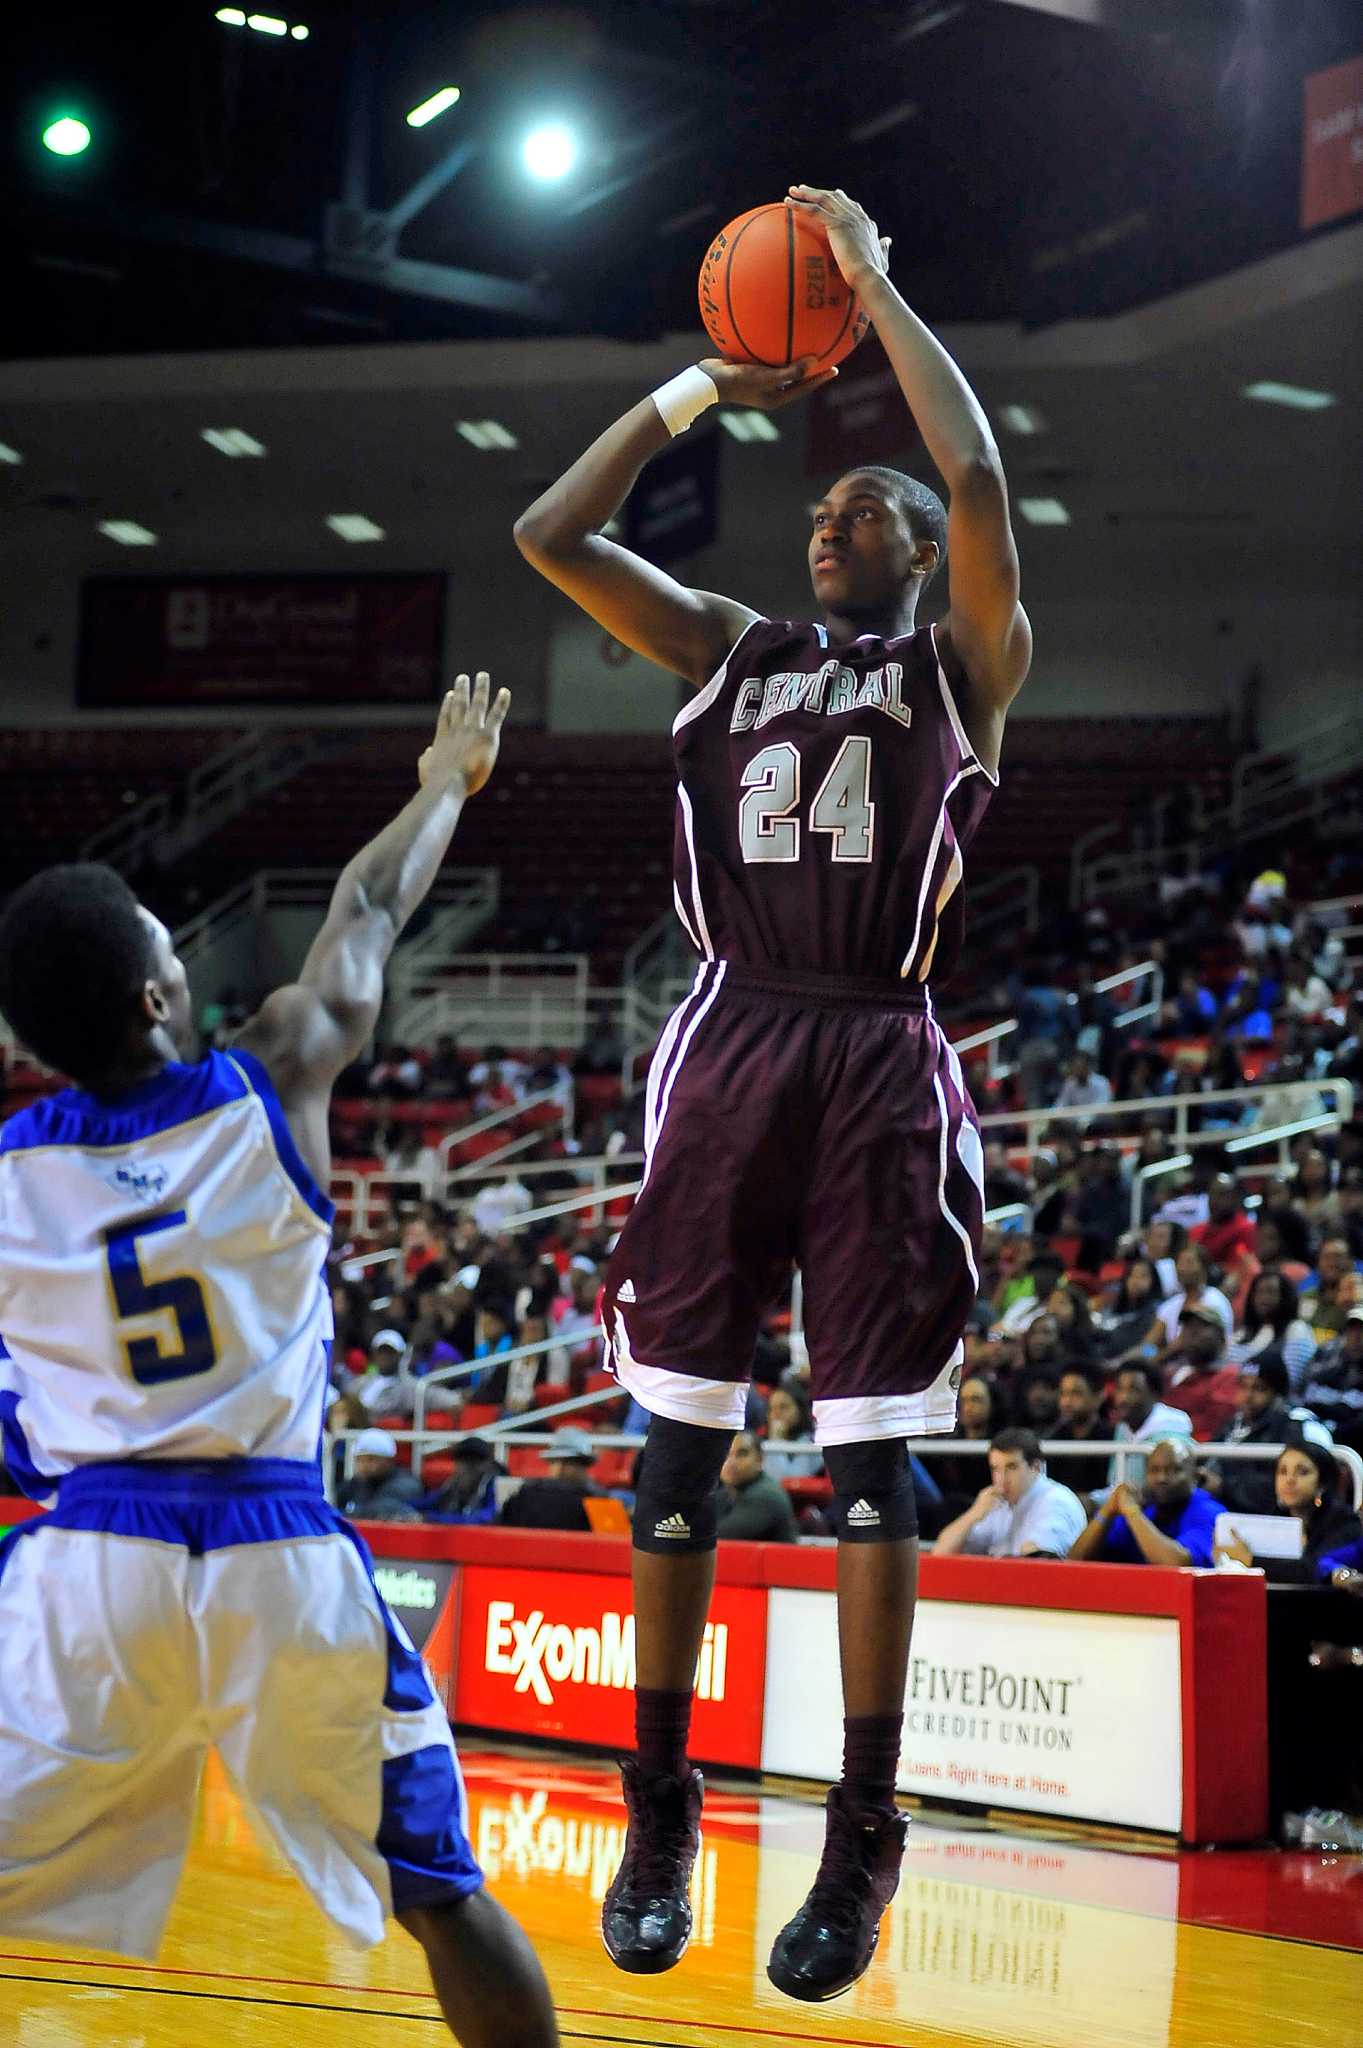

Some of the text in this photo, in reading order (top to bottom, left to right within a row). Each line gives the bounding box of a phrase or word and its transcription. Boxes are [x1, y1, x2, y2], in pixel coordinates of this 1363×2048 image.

[729, 660, 912, 734] CENTRAL
[739, 735, 875, 864] 24
[103, 1207, 219, 1388] 5
[655, 1523, 690, 1531] adidas
[485, 1600, 728, 1706] ExxonMil
[907, 1711, 1073, 1751] CREDIT UNION
